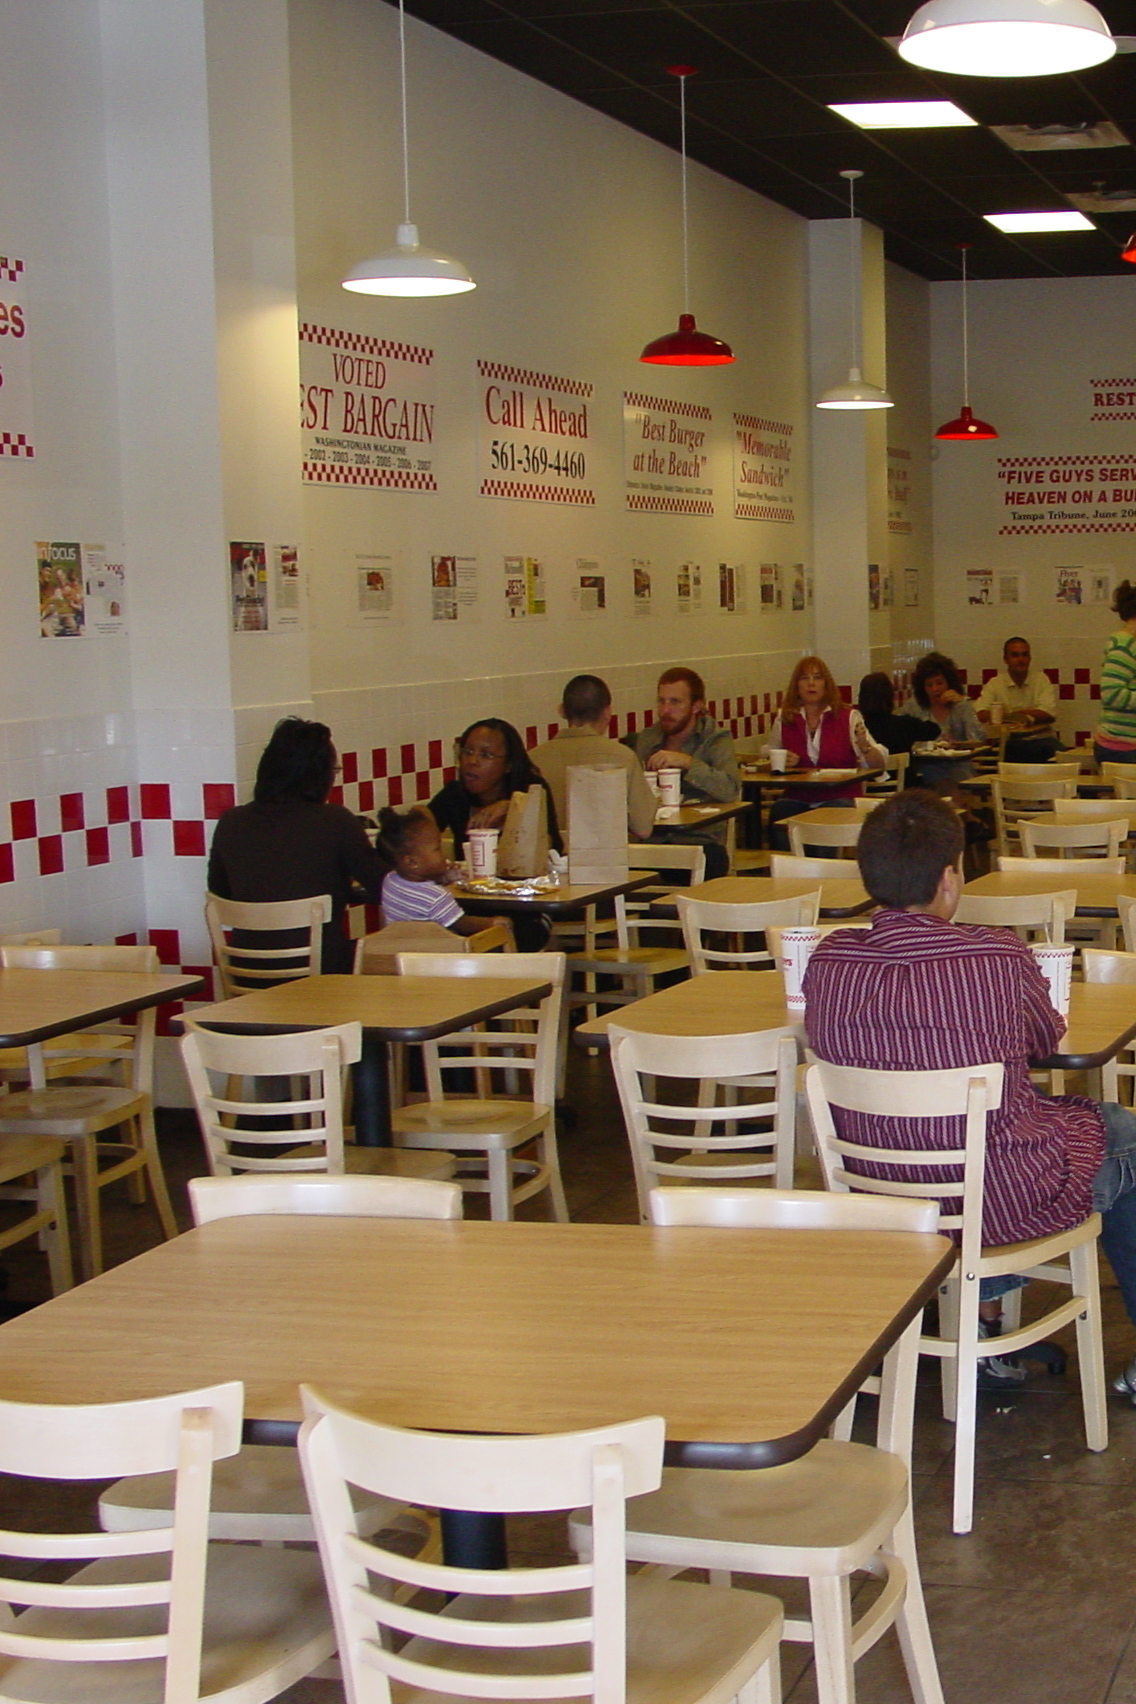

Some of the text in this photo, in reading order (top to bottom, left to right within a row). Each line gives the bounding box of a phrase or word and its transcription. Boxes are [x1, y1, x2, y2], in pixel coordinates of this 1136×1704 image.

[332, 353, 386, 390] VOTED
[342, 391, 434, 443] BARGAIN
[485, 385, 589, 438] Call Ahead
[669, 419, 705, 453] Burger
[491, 440, 586, 480] 561-369-4460
[633, 452, 644, 473] at
[648, 449, 664, 475] the
[1049, 469, 1094, 483] GUYS
[1004, 491, 1067, 506] HEAVEN
[1071, 490, 1093, 504] ON
[1097, 490, 1108, 504] A
[1011, 511, 1044, 522] Tampa
[1049, 510, 1089, 521] Tribune,
[1093, 509, 1117, 519] June
